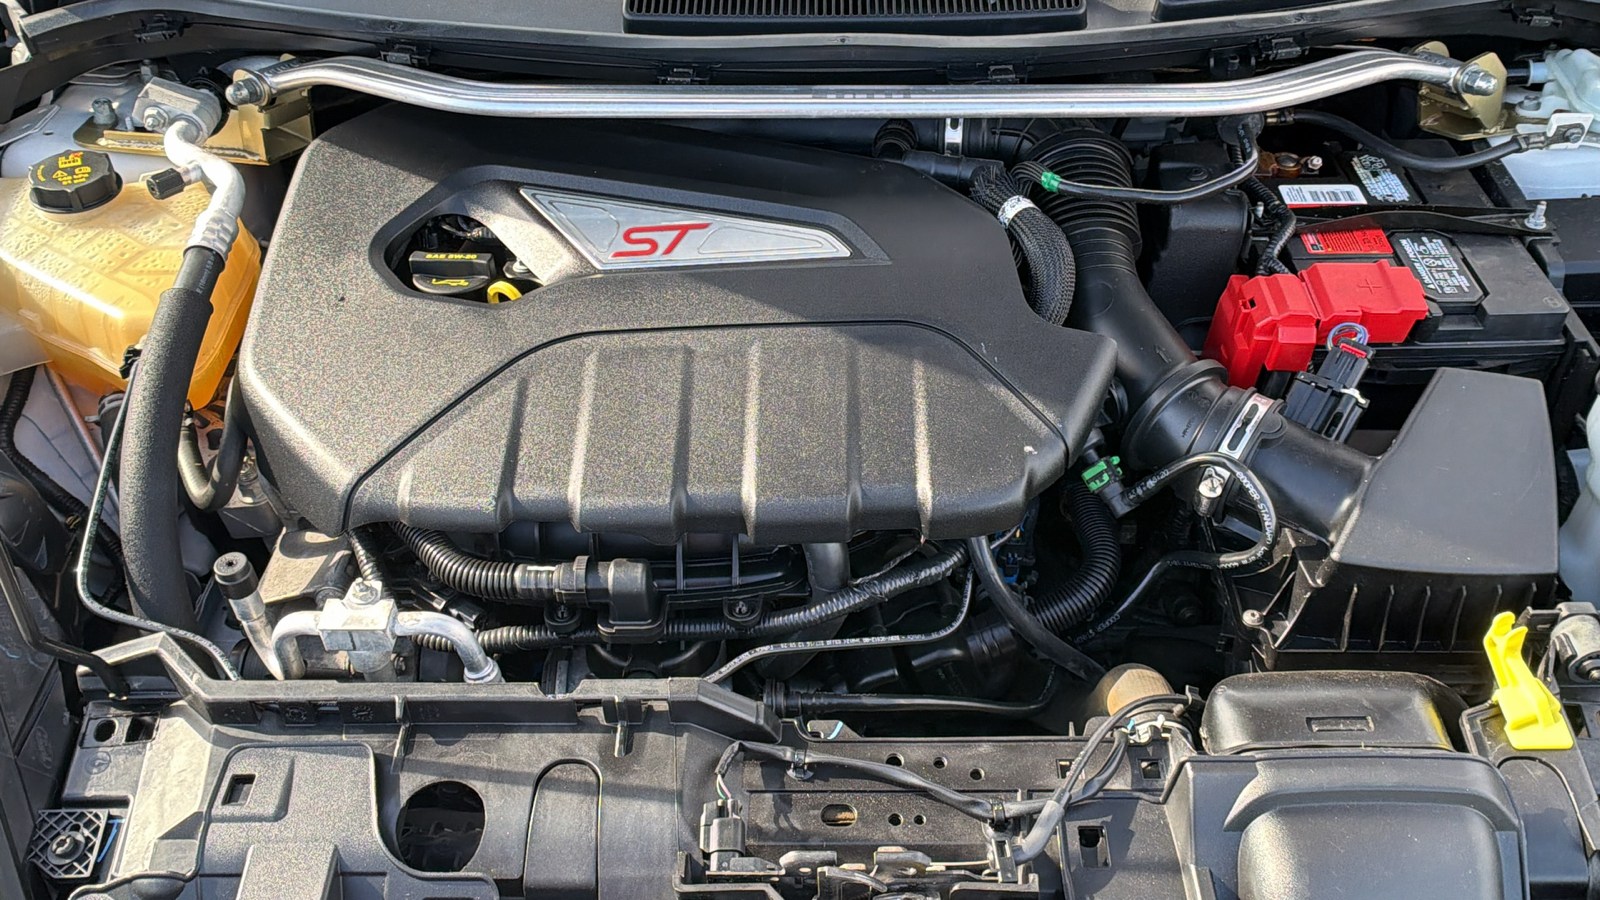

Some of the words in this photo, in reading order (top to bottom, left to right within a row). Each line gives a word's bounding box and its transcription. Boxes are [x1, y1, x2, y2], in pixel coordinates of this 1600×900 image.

[611, 222, 713, 259] ST
[1399, 239, 1415, 258] POISON
[1413, 262, 1433, 285] DANGER
